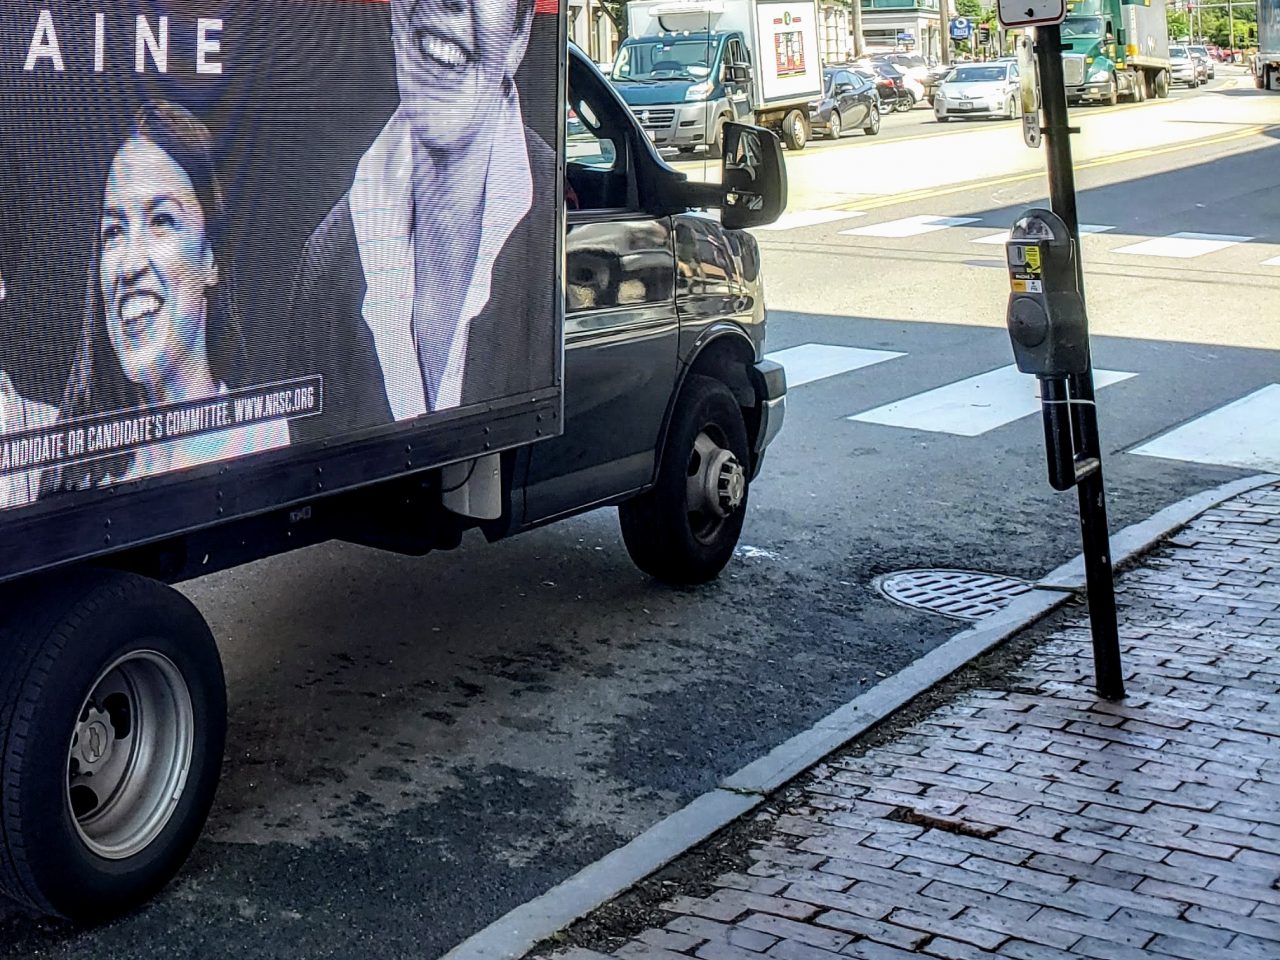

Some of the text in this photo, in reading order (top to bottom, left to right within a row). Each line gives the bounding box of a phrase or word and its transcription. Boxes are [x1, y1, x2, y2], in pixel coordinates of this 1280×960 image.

[67, 429, 84, 456] OR
[87, 415, 163, 450] CANDIDATE'S
[166, 402, 232, 436] COMMITTEE.
[233, 386, 314, 423] WWW.NRSC.ORG
